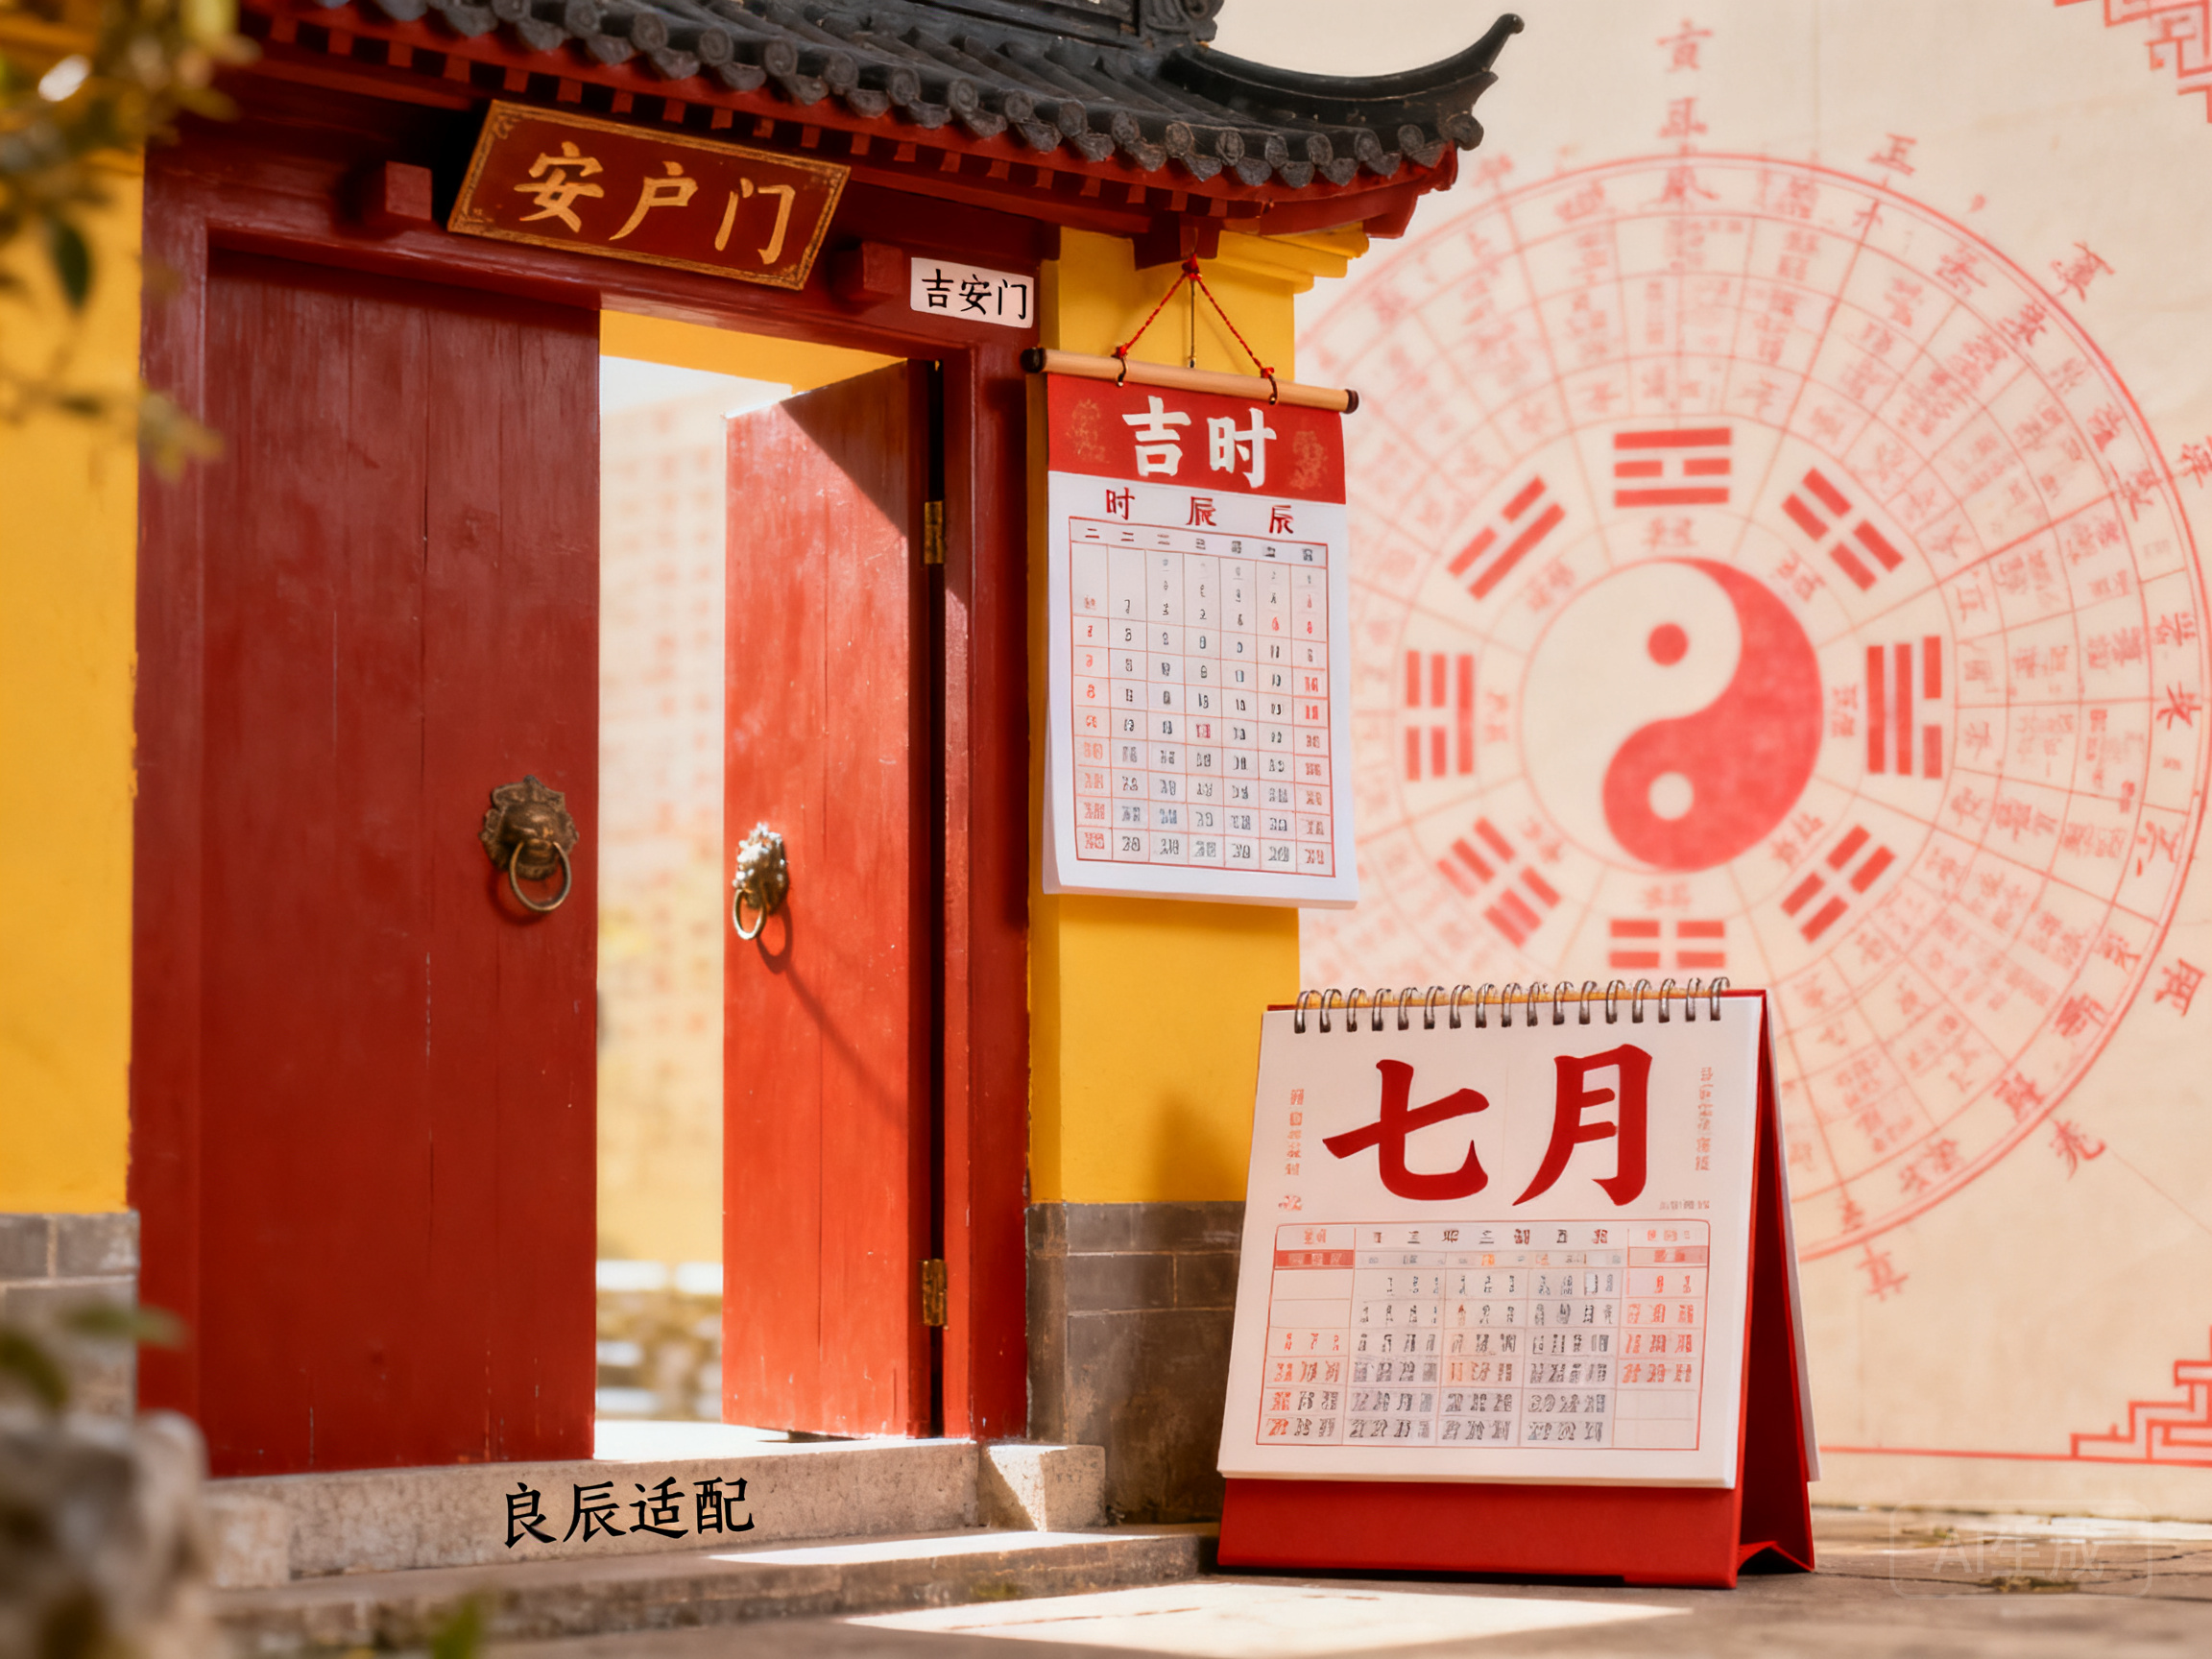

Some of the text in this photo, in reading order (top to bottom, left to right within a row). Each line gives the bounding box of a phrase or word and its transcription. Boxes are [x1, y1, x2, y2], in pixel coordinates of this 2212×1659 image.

[514, 140, 796, 266] 安户门
[921, 268, 1028, 320] 吉安门
[1121, 396, 1277, 489] 吉时
[1322, 1044, 1652, 1206] 七月
[505, 1476, 755, 1549] 良辰适配
